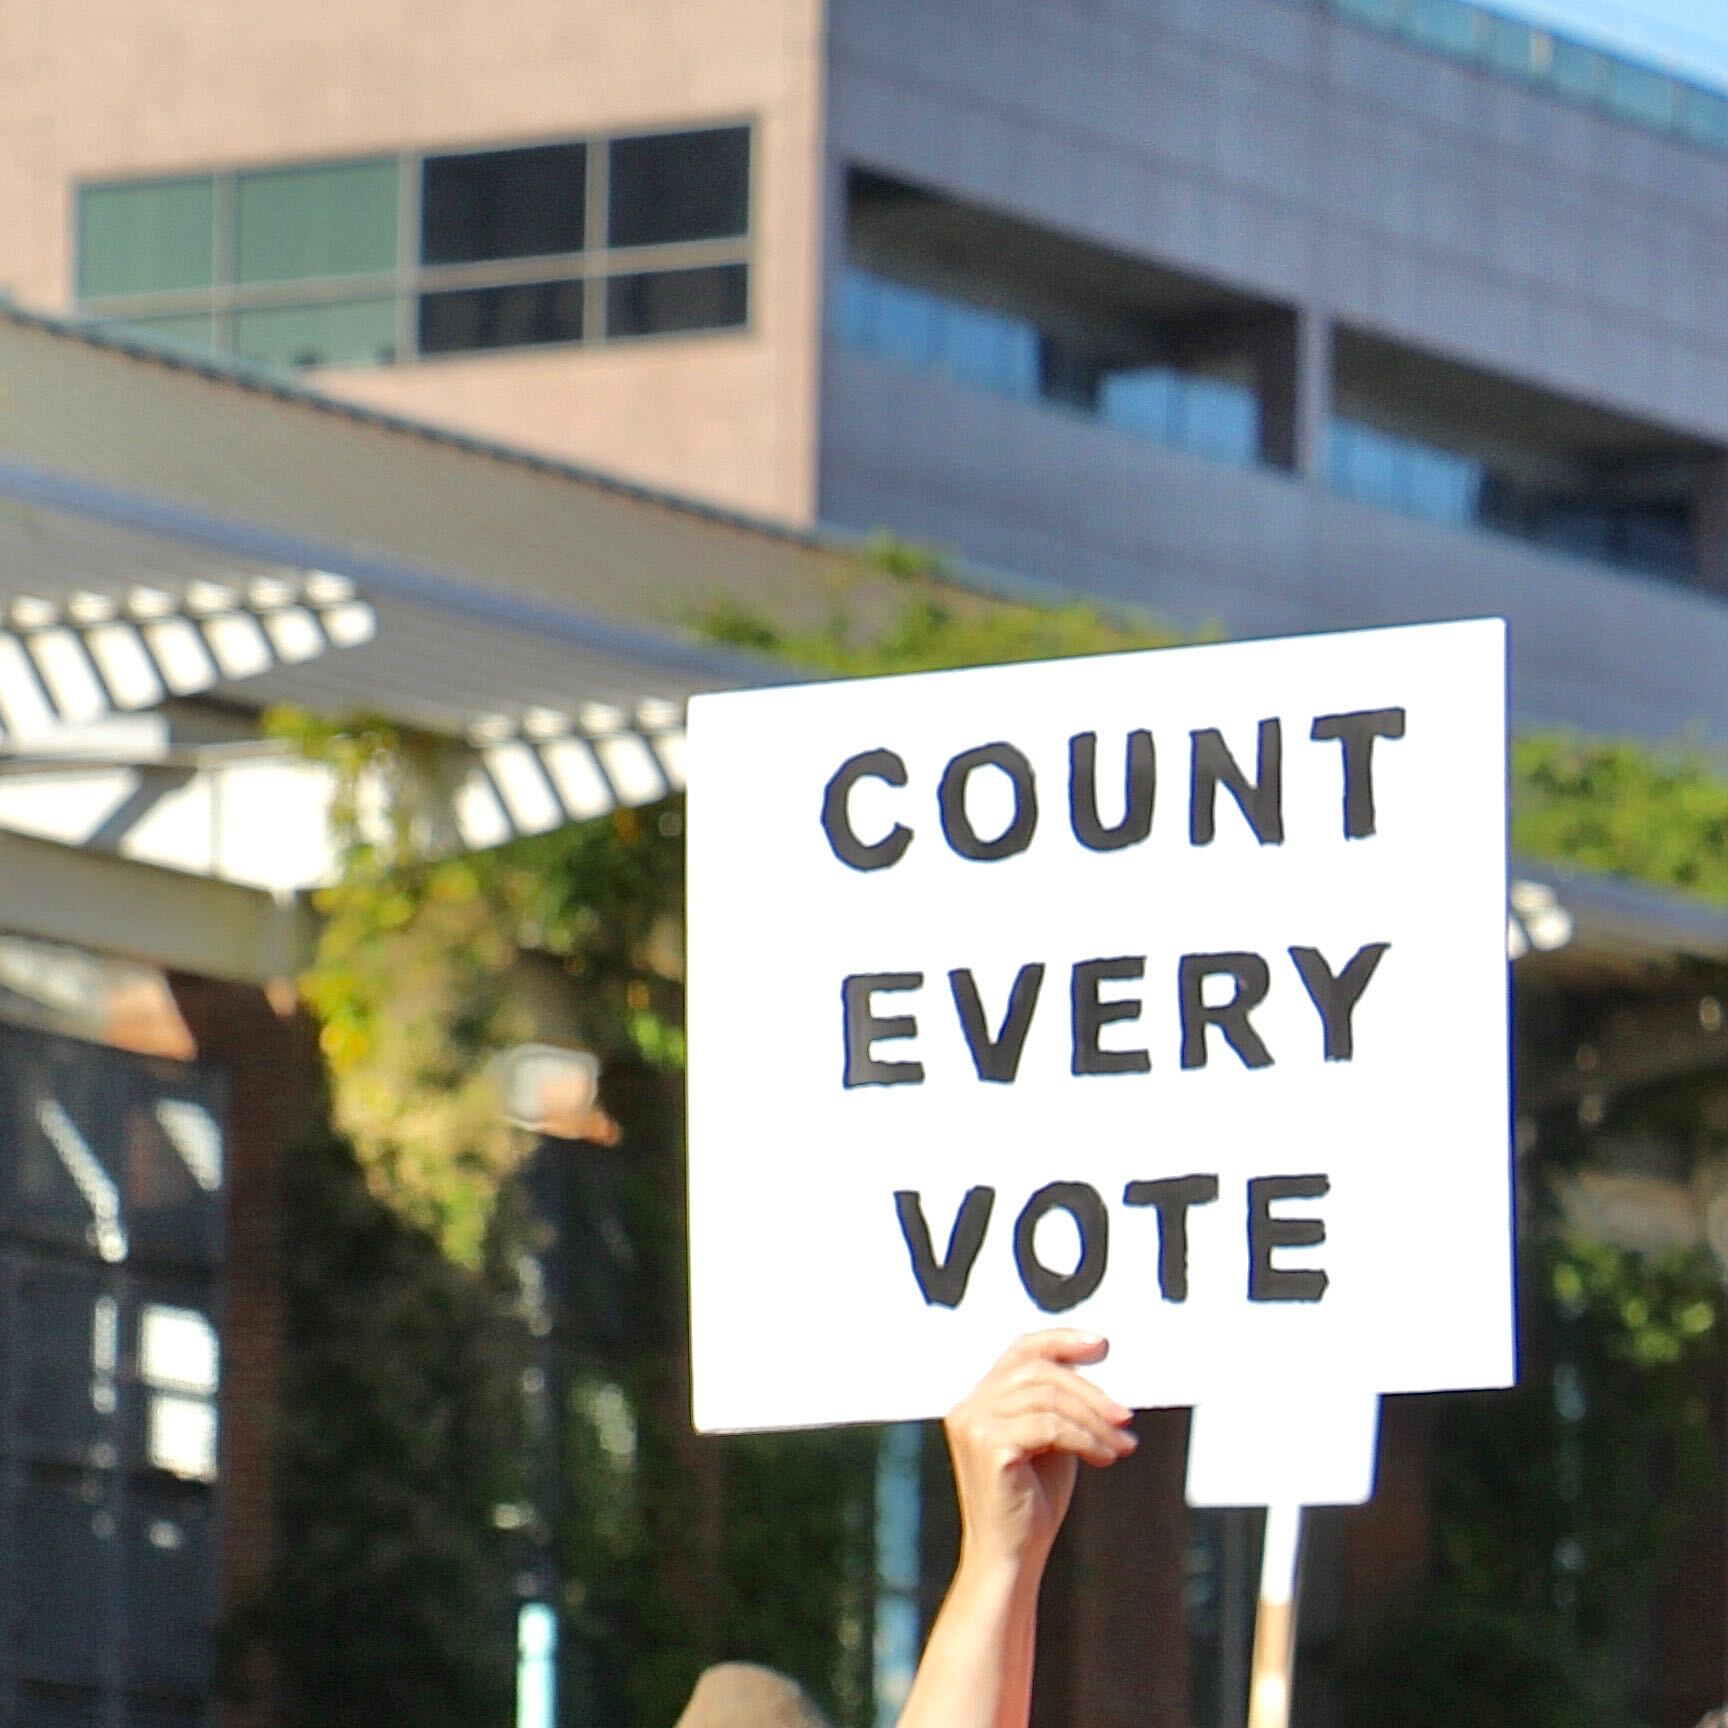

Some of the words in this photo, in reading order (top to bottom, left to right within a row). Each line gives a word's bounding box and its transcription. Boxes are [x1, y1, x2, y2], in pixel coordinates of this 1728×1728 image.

[820, 707, 1406, 873] COUNT
[841, 943, 1392, 1089] EVERY
[894, 1173, 1331, 1314] VOTE
